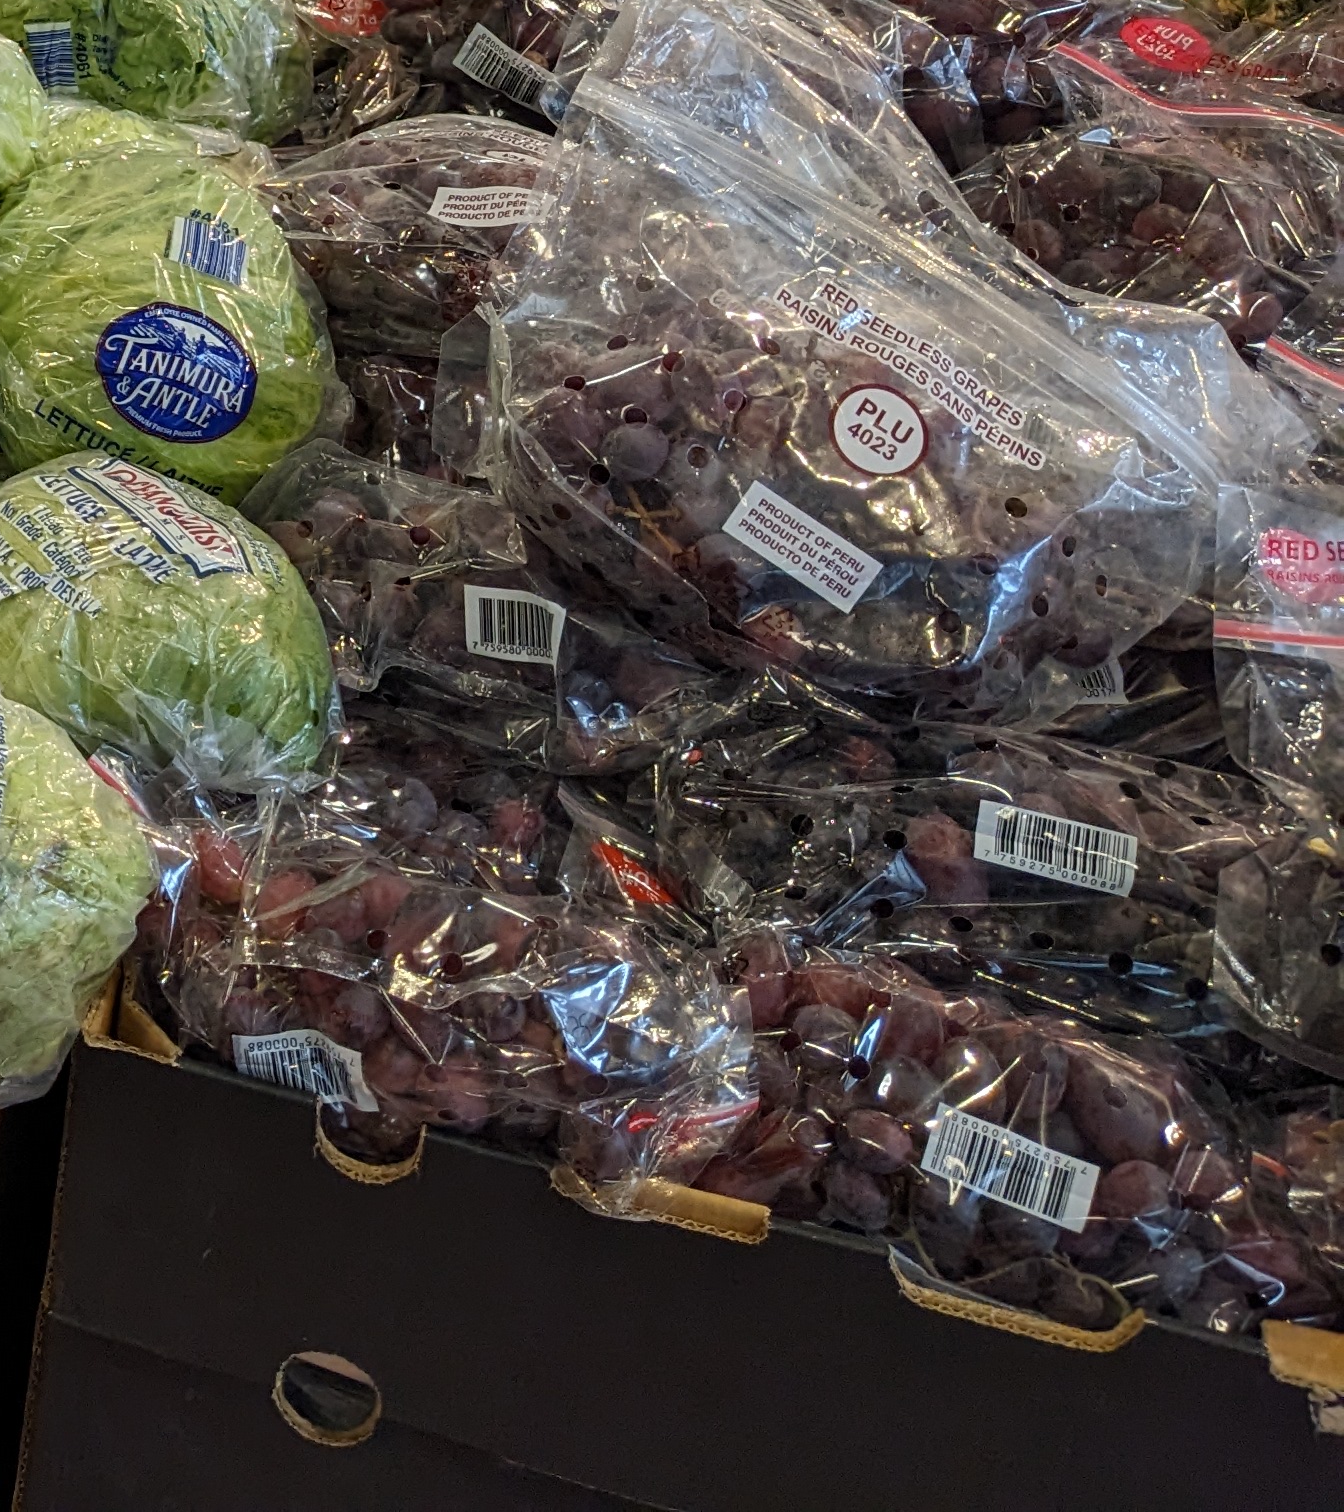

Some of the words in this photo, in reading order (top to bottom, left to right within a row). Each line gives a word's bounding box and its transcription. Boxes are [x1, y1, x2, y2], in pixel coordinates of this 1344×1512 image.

[105, 334, 247, 413] TANIMURA
[112, 377, 217, 428] ANTLE
[116, 376, 131, 395] &
[777, 290, 847, 342] RAISINS
[850, 337, 928, 386] ROUGES
[930, 381, 973, 423] SANS
[976, 417, 1043, 467] PÉPINS
[861, 311, 952, 373] SEEDLESS
[953, 370, 1023, 427] GRAPES
[35, 398, 136, 463] LETTUCE
[847, 424, 899, 461] 4023
[855, 397, 914, 444] PLU
[738, 519, 801, 566] PRODUCTO
[801, 561, 819, 578] DE
[819, 574, 851, 599] PERU
[748, 509, 798, 546] PRODUIT
[798, 540, 818, 557] DU
[817, 550, 859, 586] PÉROU
[758, 498, 815, 539] PRODUCT
[814, 534, 832, 549] OF
[831, 544, 864, 574] PERU
[1267, 539, 1318, 562] RED
